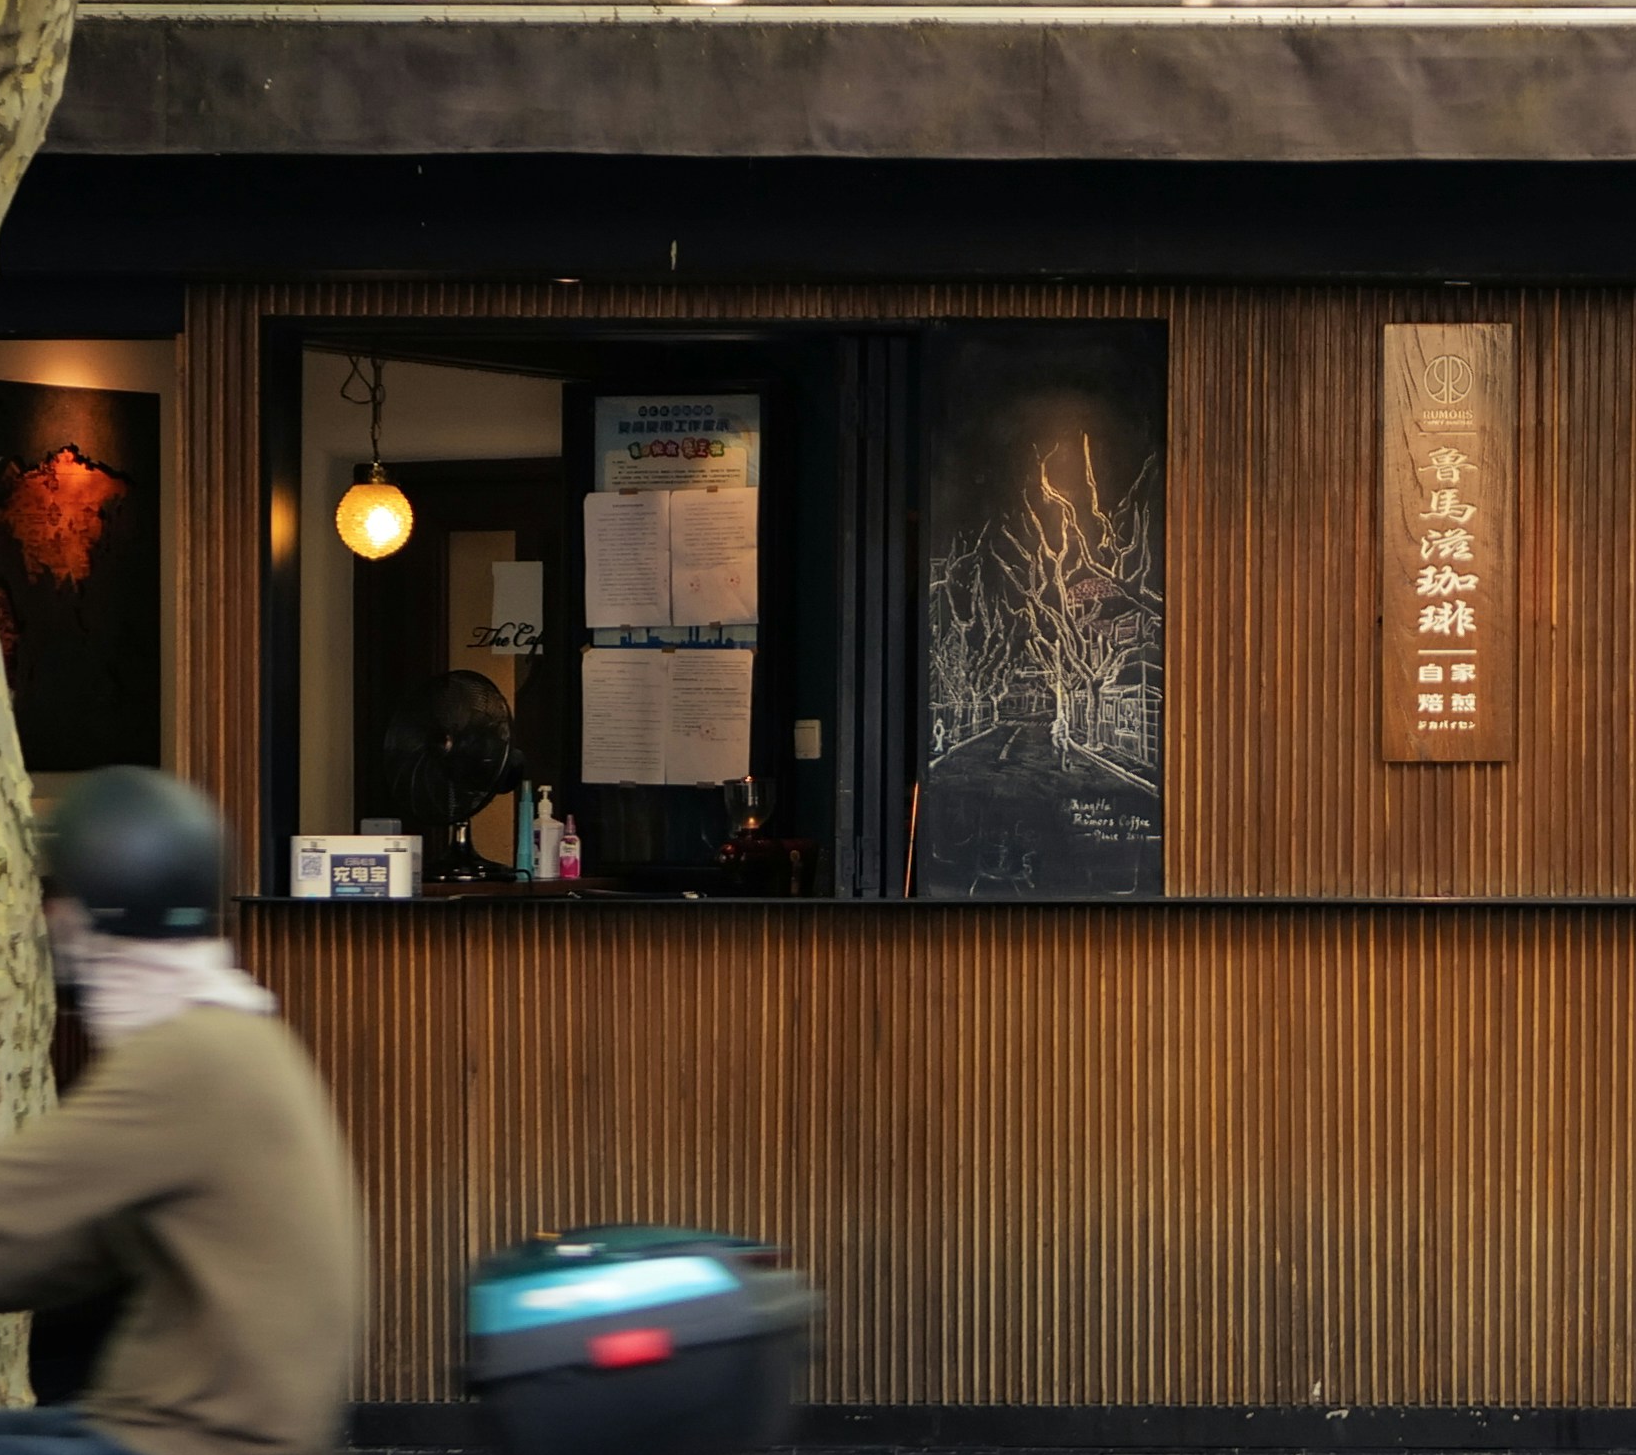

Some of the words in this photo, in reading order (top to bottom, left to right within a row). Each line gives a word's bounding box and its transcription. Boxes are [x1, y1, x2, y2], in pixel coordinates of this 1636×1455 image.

[1423, 409, 1474, 419] RUMORS
[466, 622, 516, 648] The
[1418, 663, 1476, 683] 自家
[333, 866, 388, 883] 充电宝
